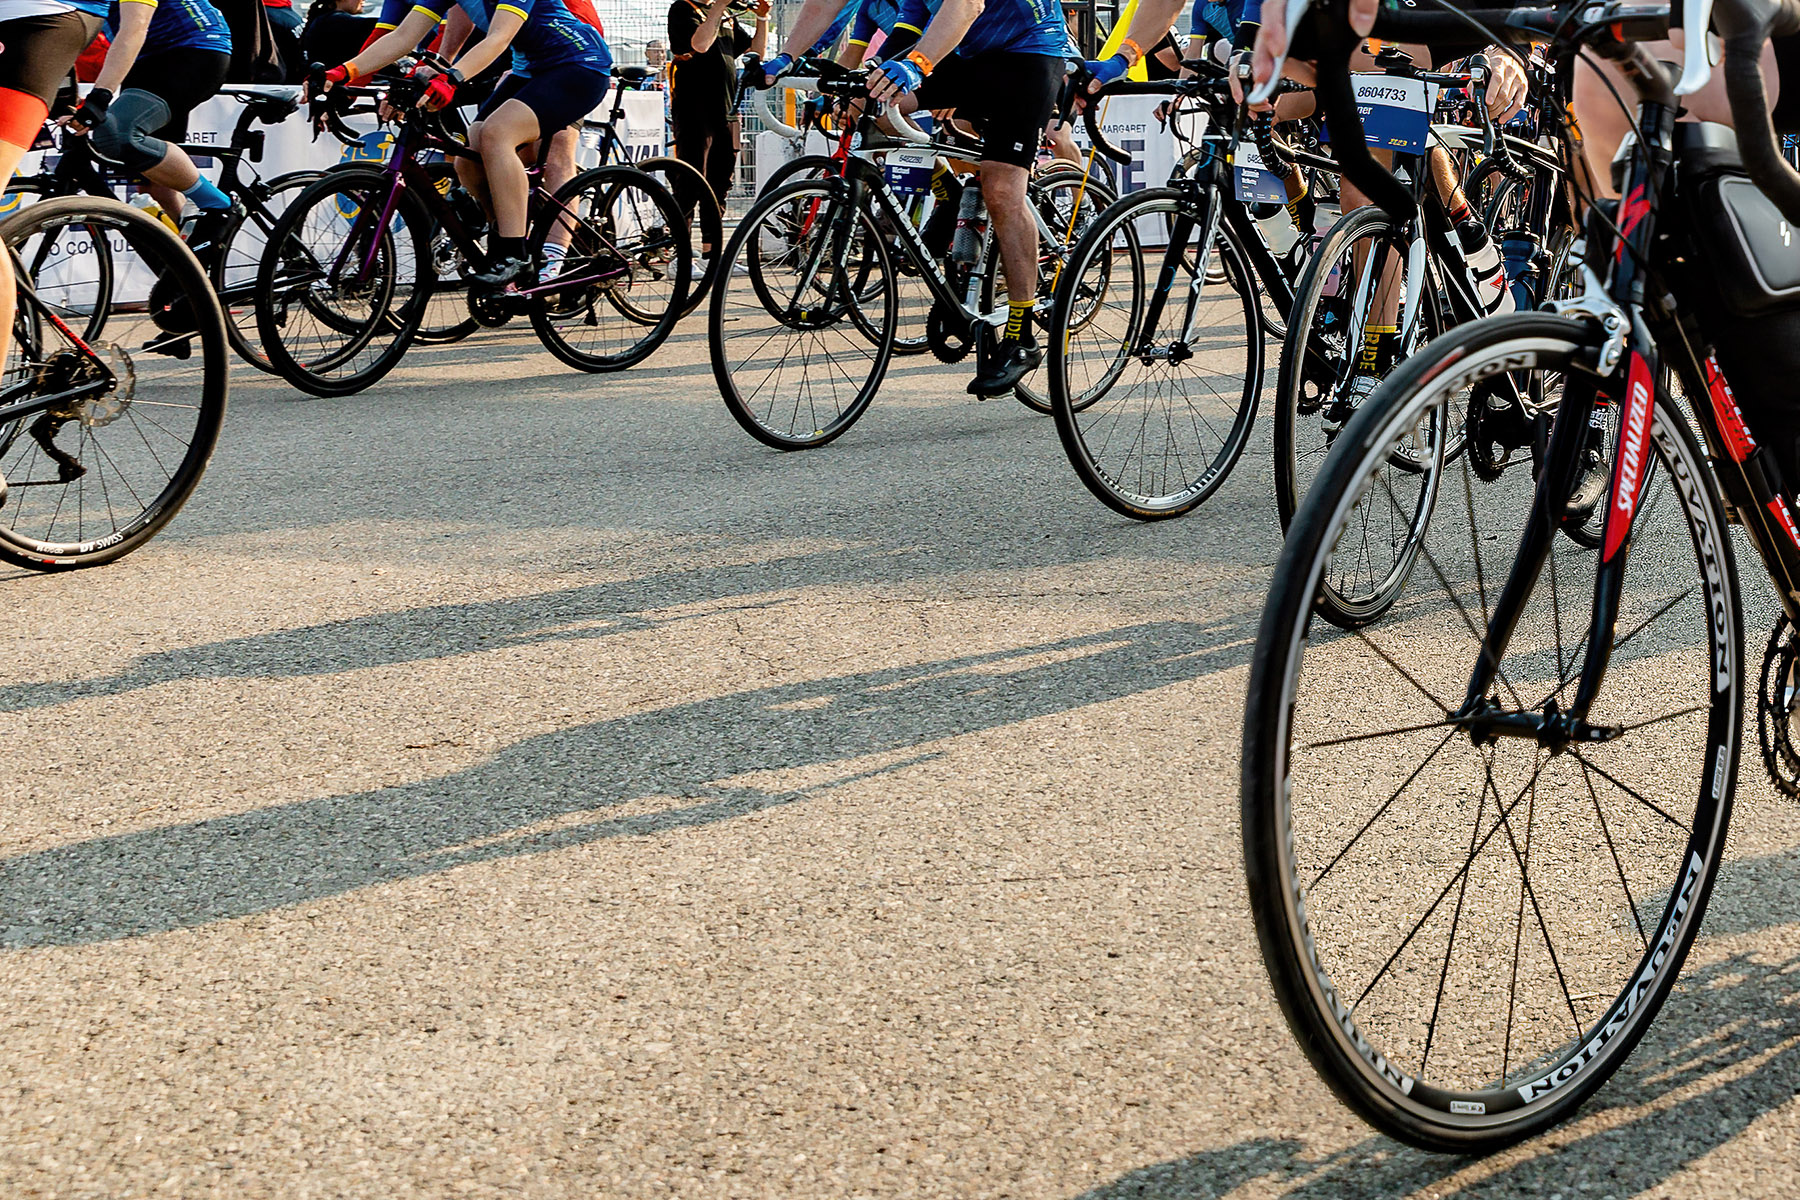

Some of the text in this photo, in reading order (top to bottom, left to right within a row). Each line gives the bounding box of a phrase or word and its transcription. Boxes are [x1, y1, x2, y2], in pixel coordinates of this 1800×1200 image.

[1357, 86, 1407, 102] 8604733
[1100, 124, 1147, 135] MARGARET
[1005, 308, 1025, 341] RIDE
[1359, 332, 1381, 371] RIDE
[1616, 380, 1649, 522] SPECIALIZED
[80, 542, 96, 552] DT
[96, 532, 124, 549] SWISS
[1530, 868, 1700, 1100] NEUVATION
